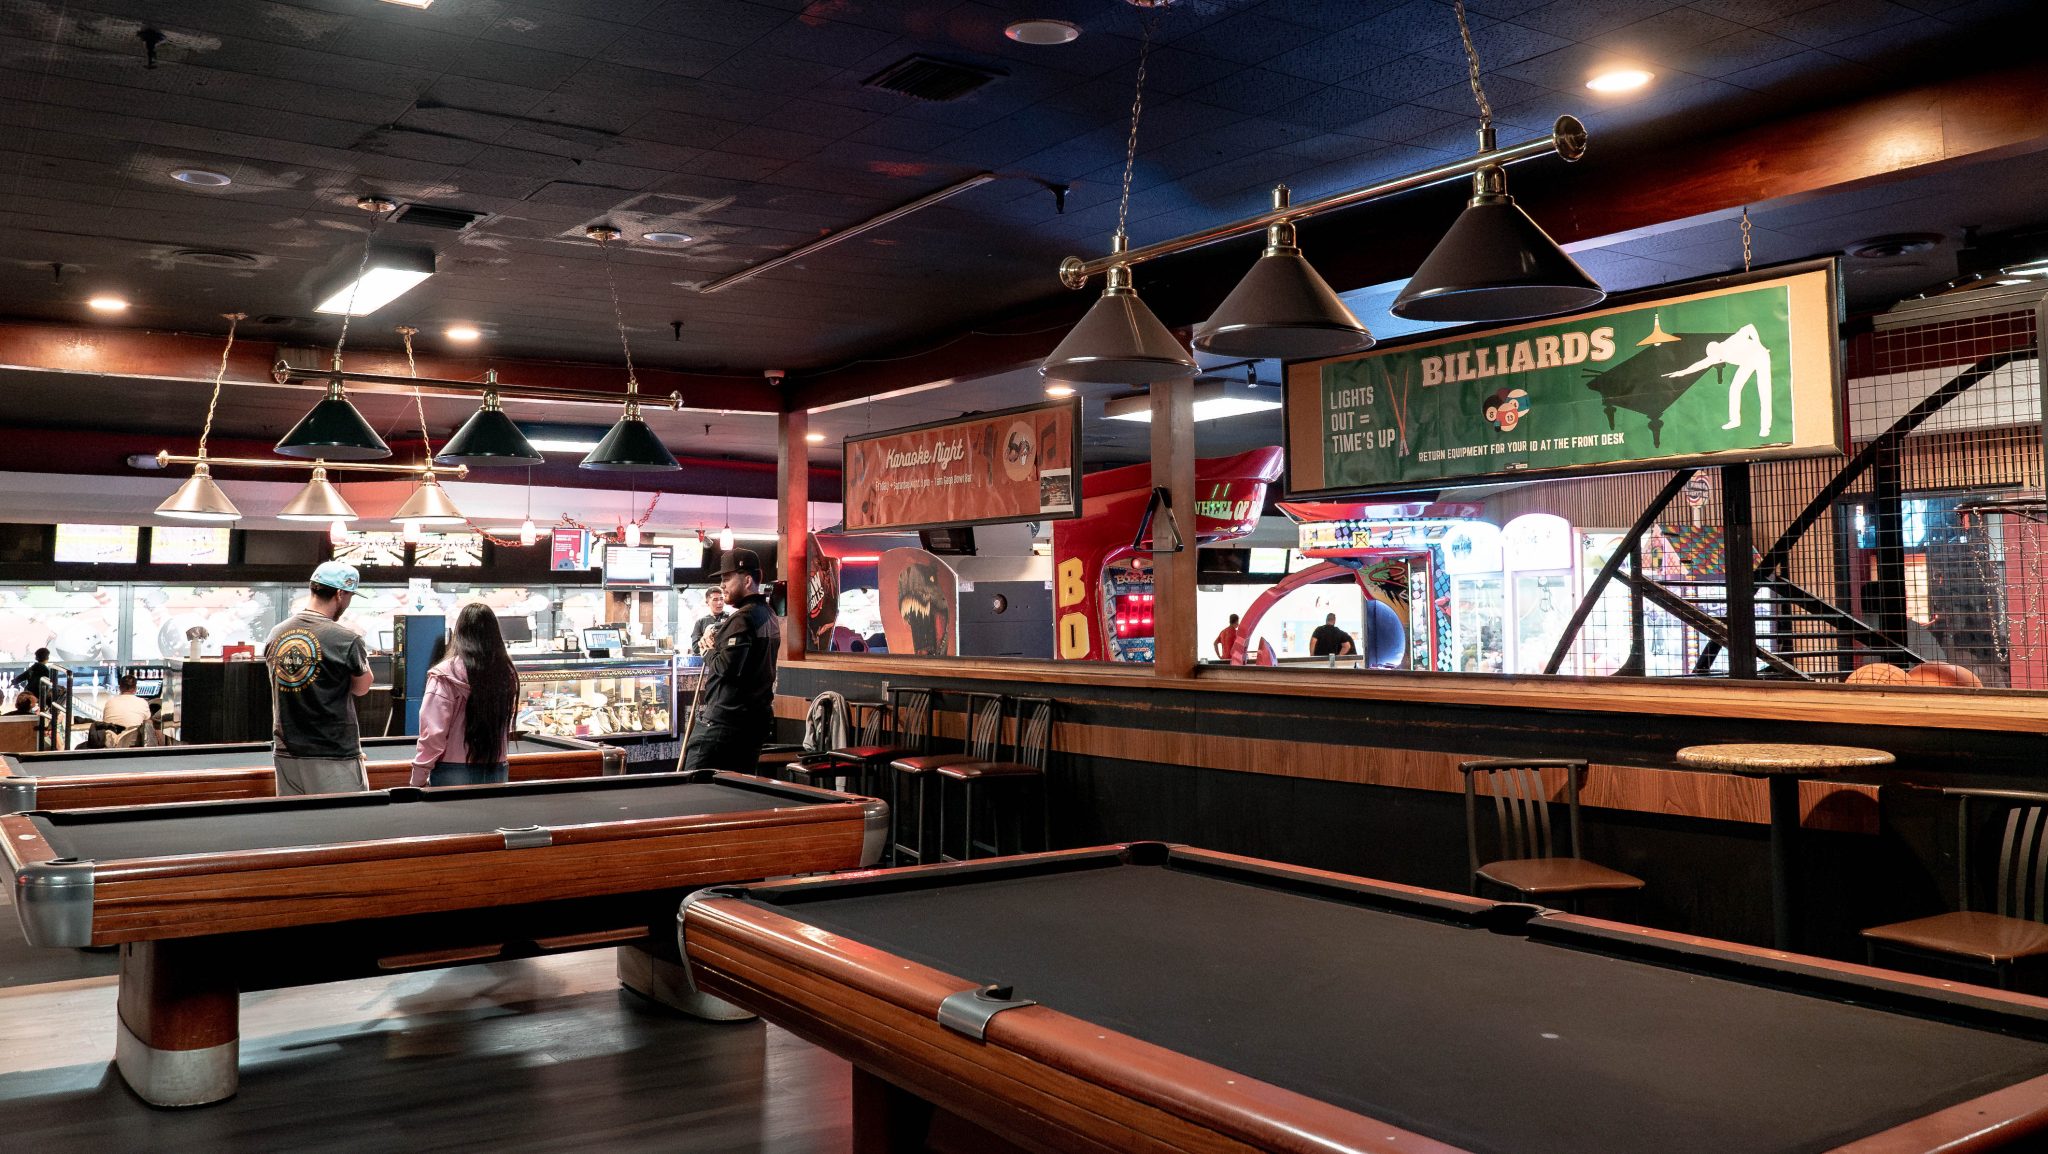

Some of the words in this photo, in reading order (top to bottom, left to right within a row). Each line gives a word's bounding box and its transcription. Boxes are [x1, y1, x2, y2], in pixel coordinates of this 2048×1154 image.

[1421, 326, 1616, 388] BILLIARDS
[1330, 386, 1374, 410] LIGHTS
[1331, 411, 1355, 432] OUT
[1331, 431, 1374, 454] TIME'S
[1378, 428, 1395, 448] UP
[1418, 449, 1446, 462] RETURN
[1447, 444, 1489, 460] EQUIPMENT
[1490, 443, 1505, 455] FOR
[1507, 440, 1527, 453] YOUR
[1529, 440, 1538, 452] ID
[1540, 439, 1551, 451] AT
[1553, 437, 1569, 450] THE
[1571, 434, 1599, 448] FRONT
[1601, 432, 1625, 446] DESK
[886, 444, 932, 469] Karaoke
[932, 438, 965, 471] Night
[875, 480, 889, 493] Friday
